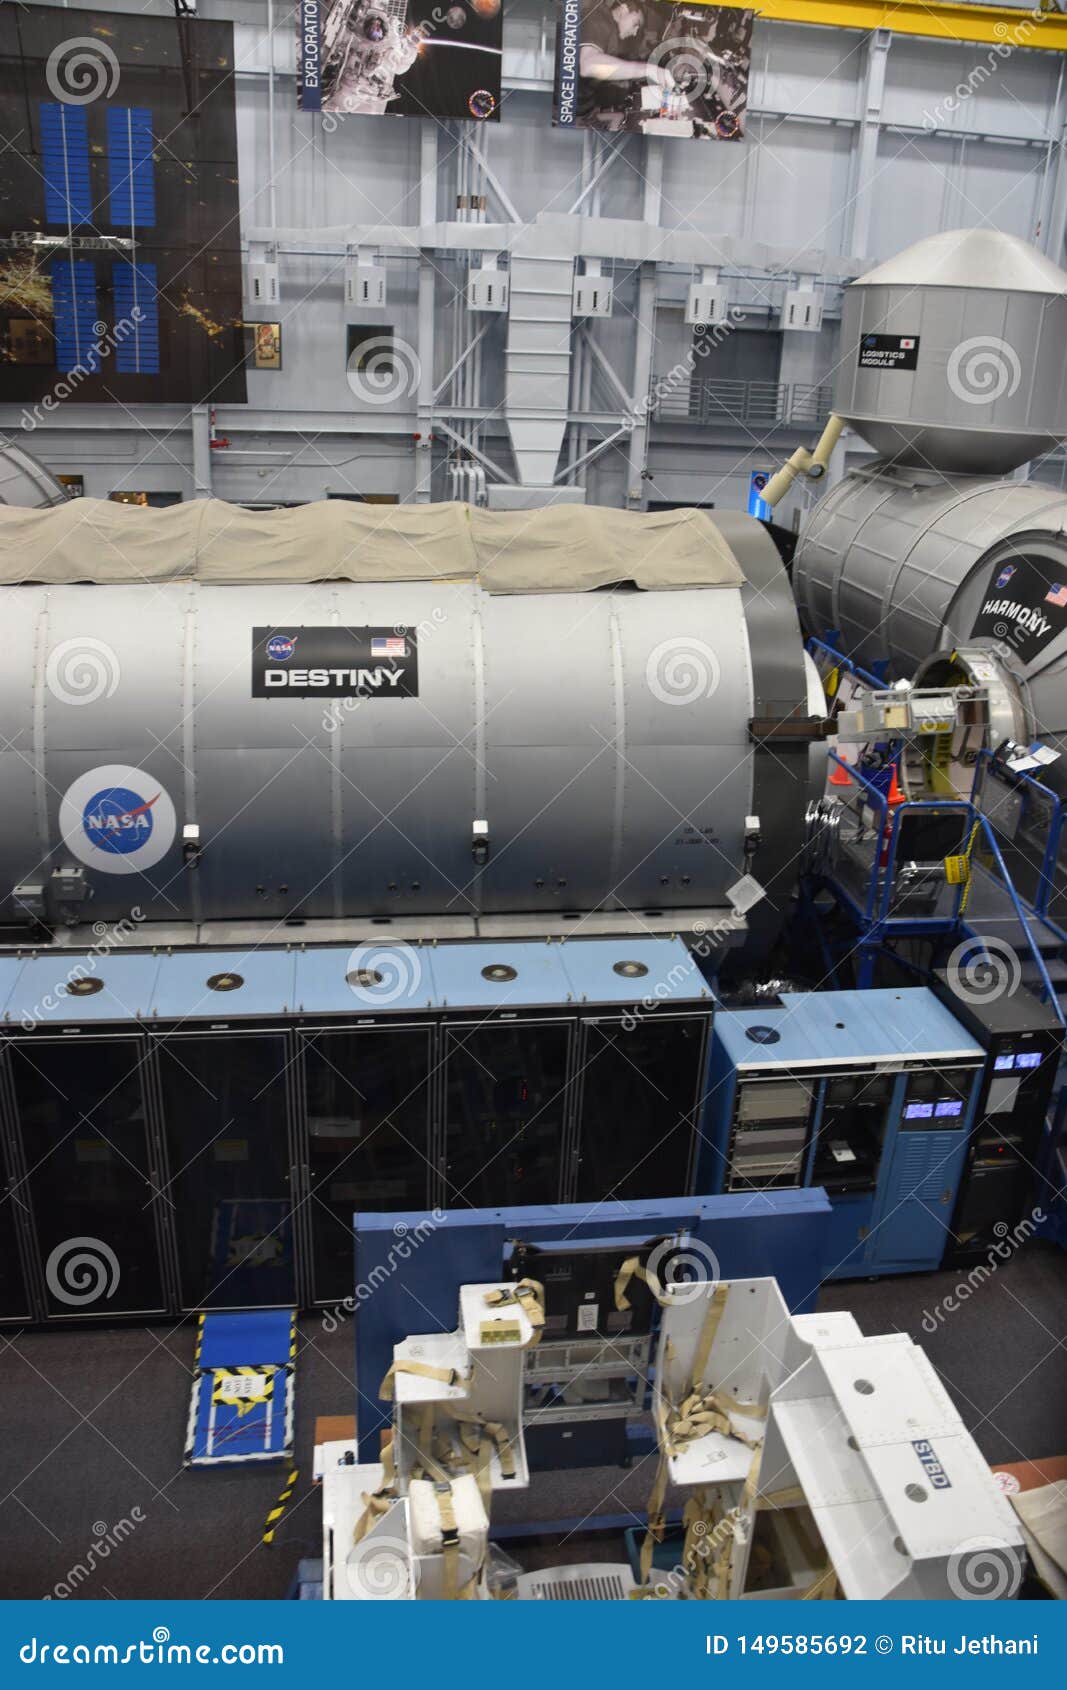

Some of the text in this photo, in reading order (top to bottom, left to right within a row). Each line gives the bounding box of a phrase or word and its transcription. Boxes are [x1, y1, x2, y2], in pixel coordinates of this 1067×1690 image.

[560, 82, 575, 123] SPACE
[861, 358, 895, 367] MODULE
[862, 350, 905, 359] LOGISTICS
[981, 599, 1052, 638] HARMONY
[264, 668, 406, 687] DESTINY
[88, 814, 150, 829] NASA
[914, 1442, 948, 1487] STBD
